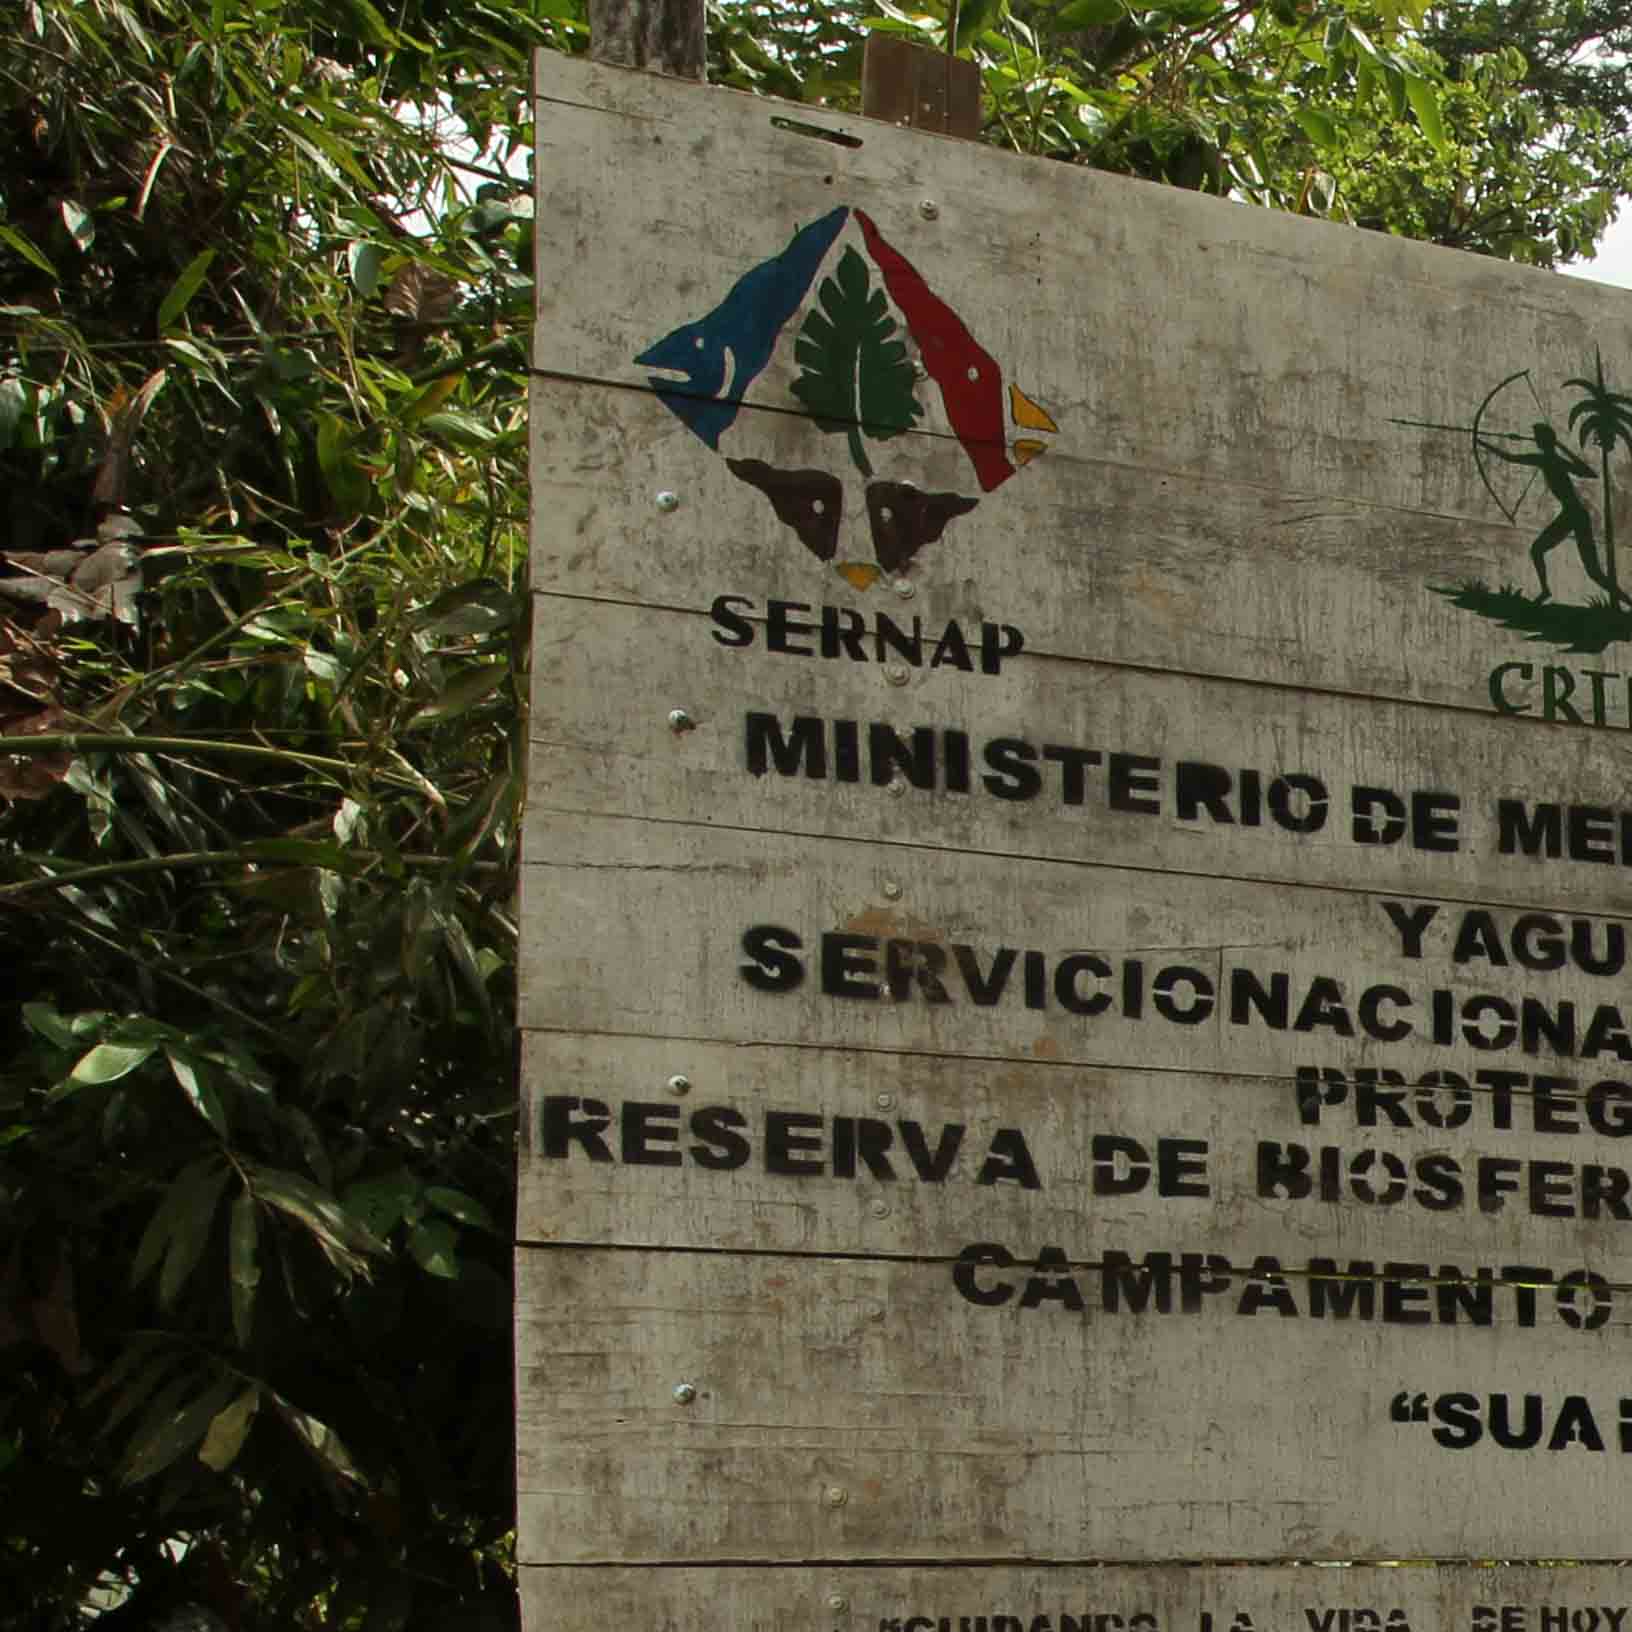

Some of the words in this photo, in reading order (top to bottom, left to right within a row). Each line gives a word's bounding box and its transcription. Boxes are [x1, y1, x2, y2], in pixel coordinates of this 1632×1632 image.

[710, 595, 1025, 675] SERNAP
[745, 711, 1330, 832] MINISTERIO
[1350, 785, 1459, 854] DE
[541, 1096, 1042, 1189] RESERVA
[1092, 1134, 1210, 1197] DE
[952, 1242, 1612, 1330] CAMPAMENTO
